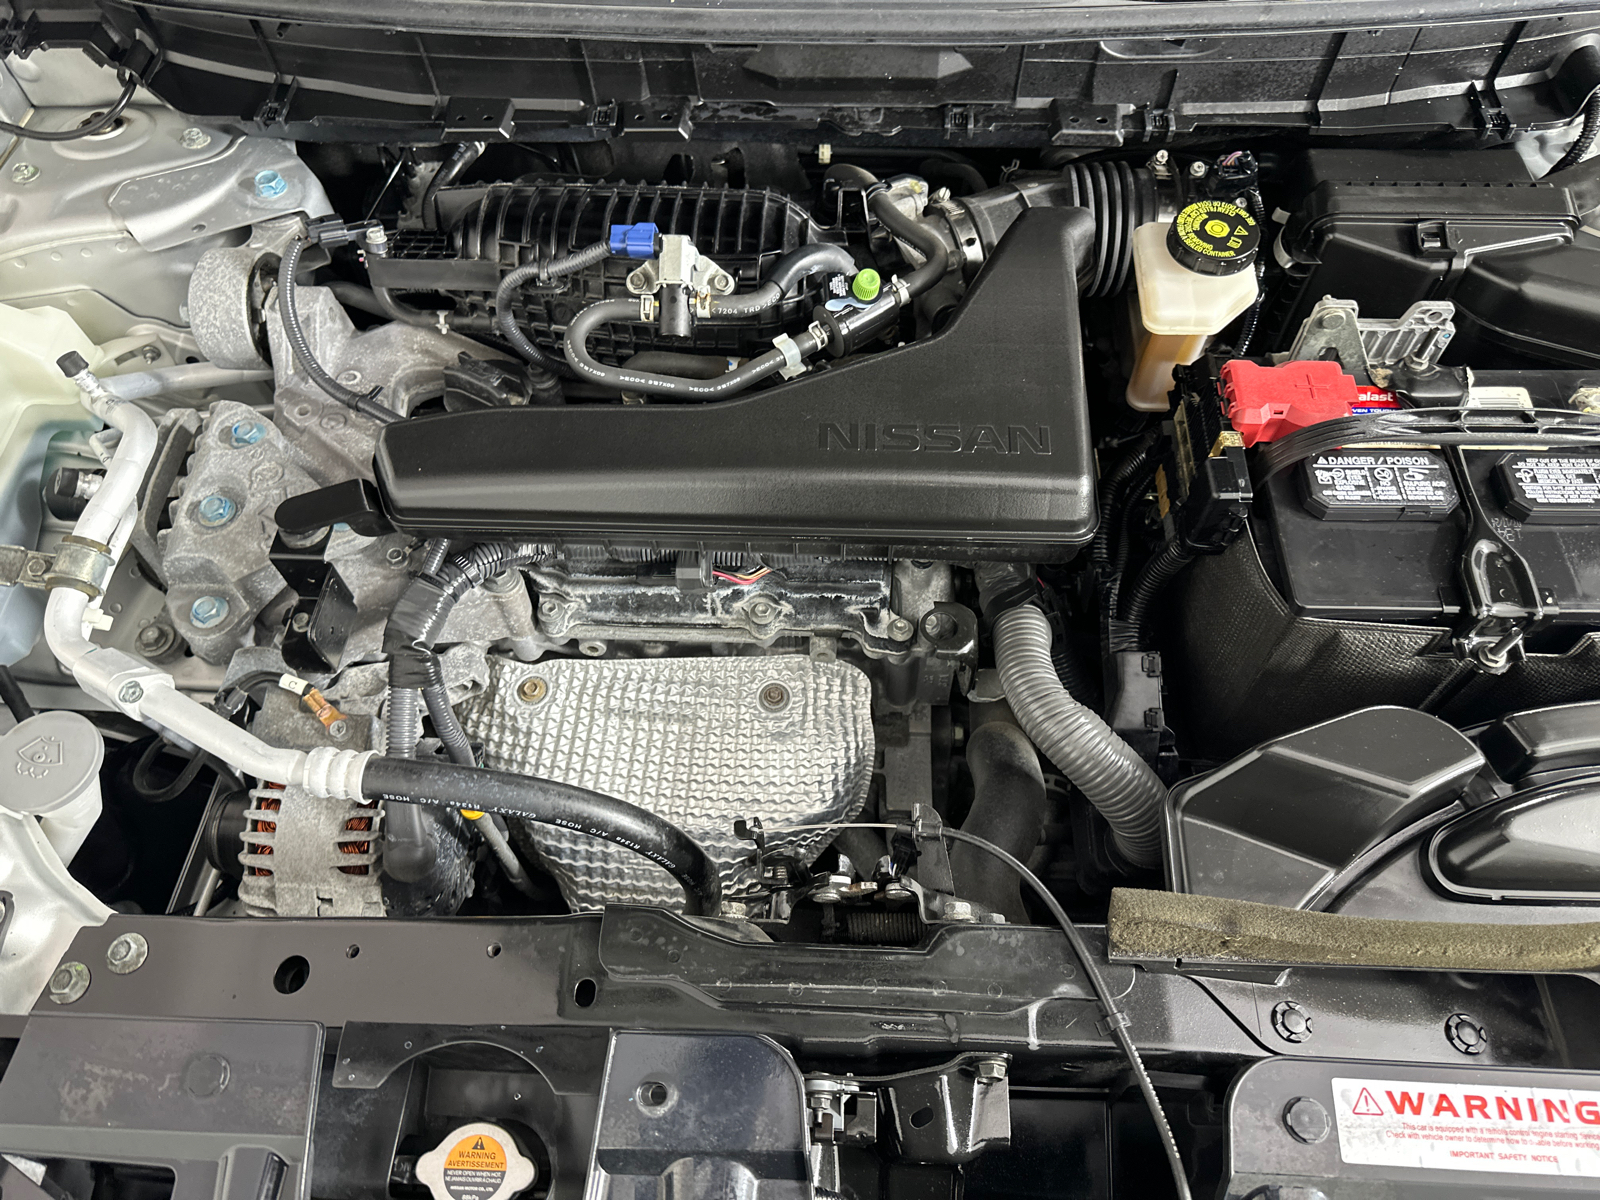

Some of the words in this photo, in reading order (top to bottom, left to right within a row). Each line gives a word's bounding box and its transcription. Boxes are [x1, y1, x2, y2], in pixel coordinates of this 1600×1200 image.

[1358, 391, 1394, 402] alast
[818, 422, 1051, 455] NISSAN
[1328, 456, 1375, 465] DANGER
[1387, 456, 1430, 466] POISON
[288, 680, 298, 690] C
[382, 793, 410, 802] HOSE
[419, 797, 439, 805] A/C
[489, 806, 537, 819] GALAXY
[554, 818, 582, 830] HOSE
[589, 828, 609, 837] A/C
[645, 850, 676, 869] GALAXY
[1384, 1090, 1600, 1126] WARNING
[1402, 1122, 1416, 1131] This
[1434, 1125, 1464, 1134] equipped
[1466, 1126, 1479, 1134] with
[1554, 1131, 1578, 1140] starting
[1386, 1129, 1407, 1139] Check
[1421, 1132, 1443, 1141] vehicle
[1444, 1134, 1464, 1142] owner
[1473, 1136, 1505, 1144] determine
[1552, 1139, 1573, 1148] before
[1574, 1141, 1600, 1151] working
[458, 1150, 497, 1160] WARNING
[1450, 1150, 1494, 1160] IMPORTANT
[1498, 1152, 1527, 1161] SAFETY
[1531, 1155, 1559, 1163] NOTICE
[447, 1160, 504, 1169] AVERTISSEMENT
